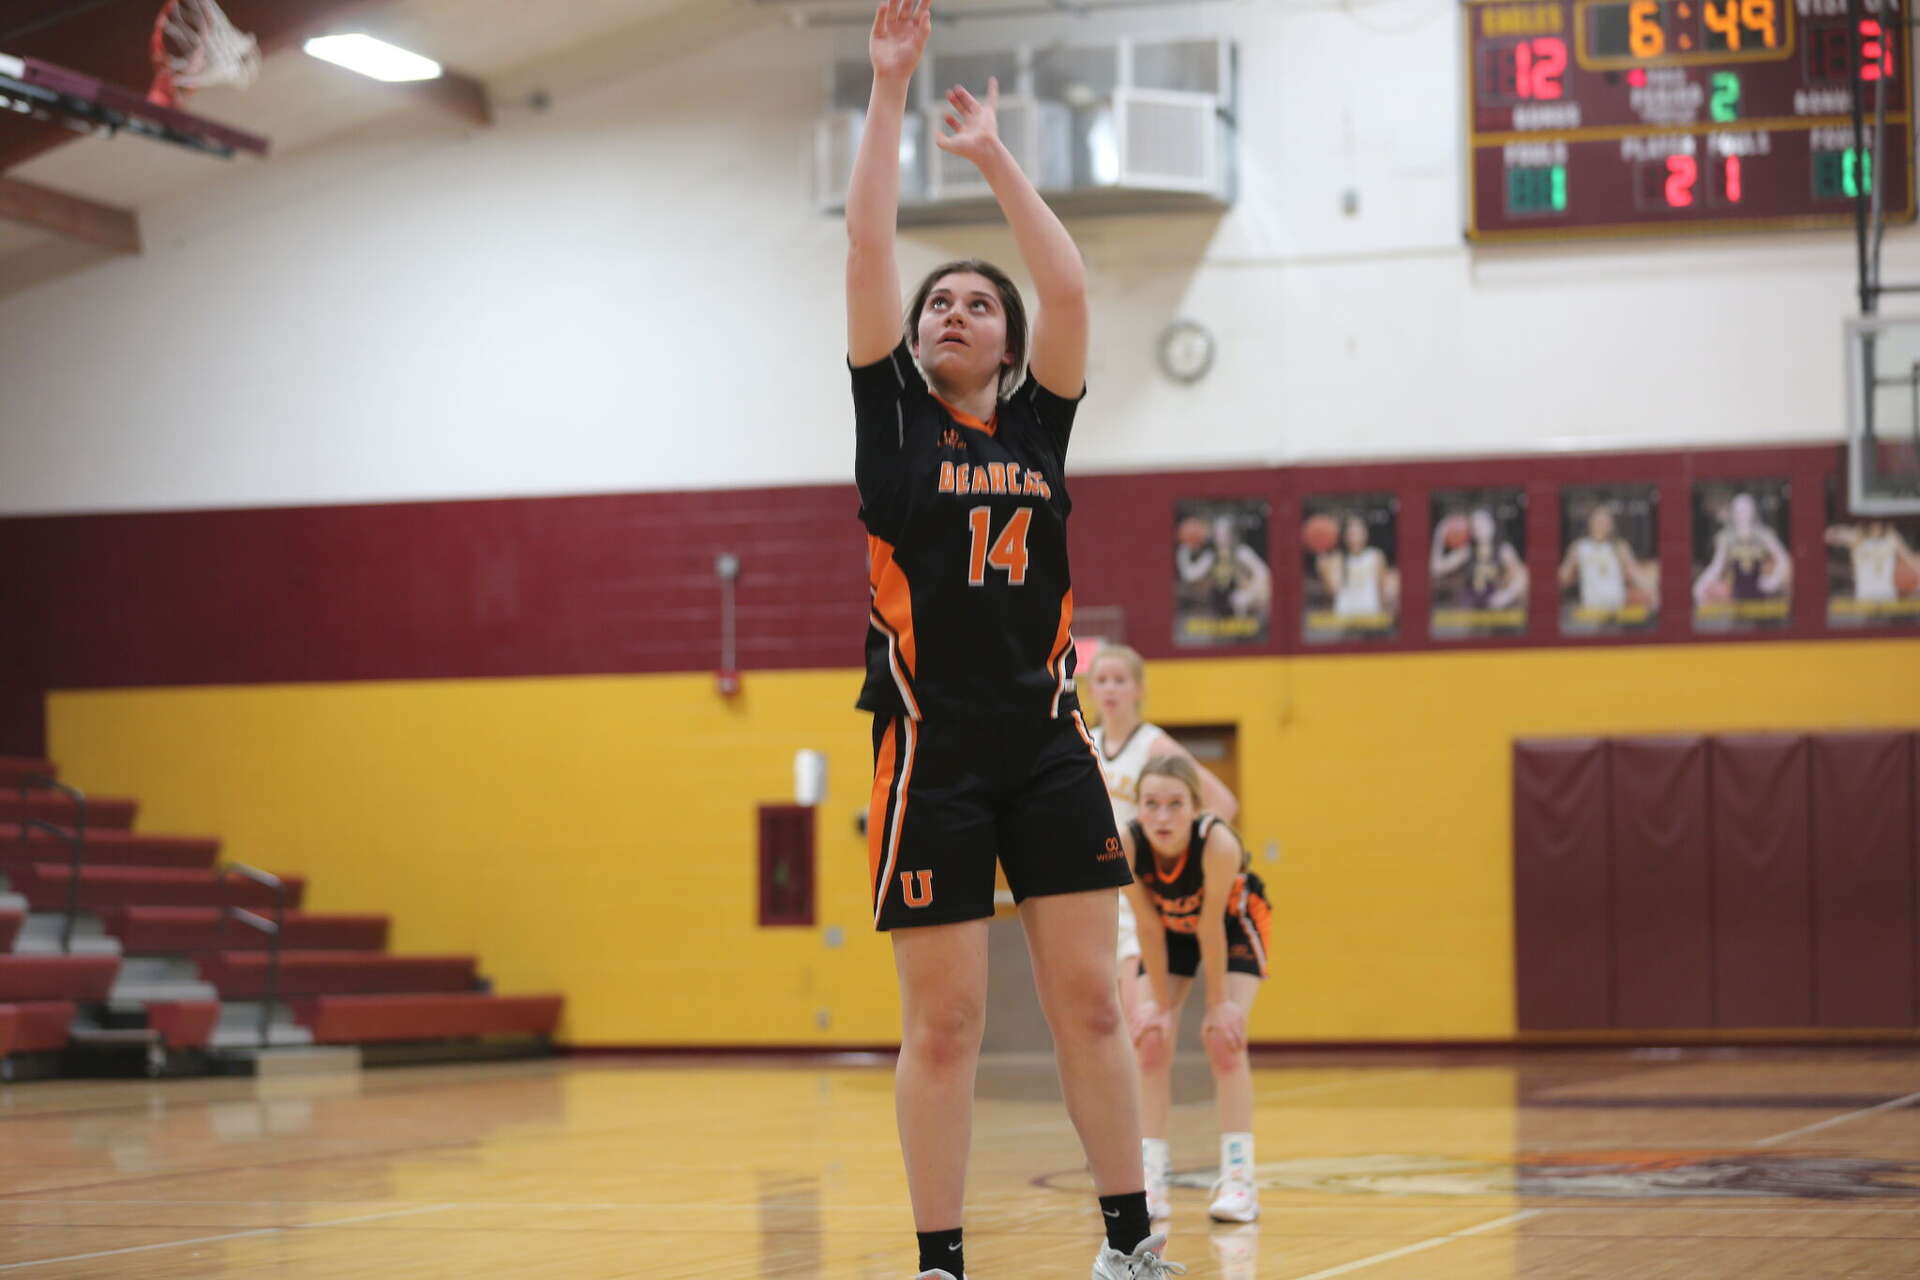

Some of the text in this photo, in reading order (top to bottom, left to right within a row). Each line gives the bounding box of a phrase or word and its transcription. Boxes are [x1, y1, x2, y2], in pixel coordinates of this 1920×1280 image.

[1515, 37, 1568, 100] 12
[1710, 71, 1740, 123] 2
[1551, 164, 1567, 211] 1
[1664, 155, 1697, 207] 2
[1725, 153, 1741, 203] 1
[968, 506, 1033, 587] 14
[900, 870, 934, 908] U
